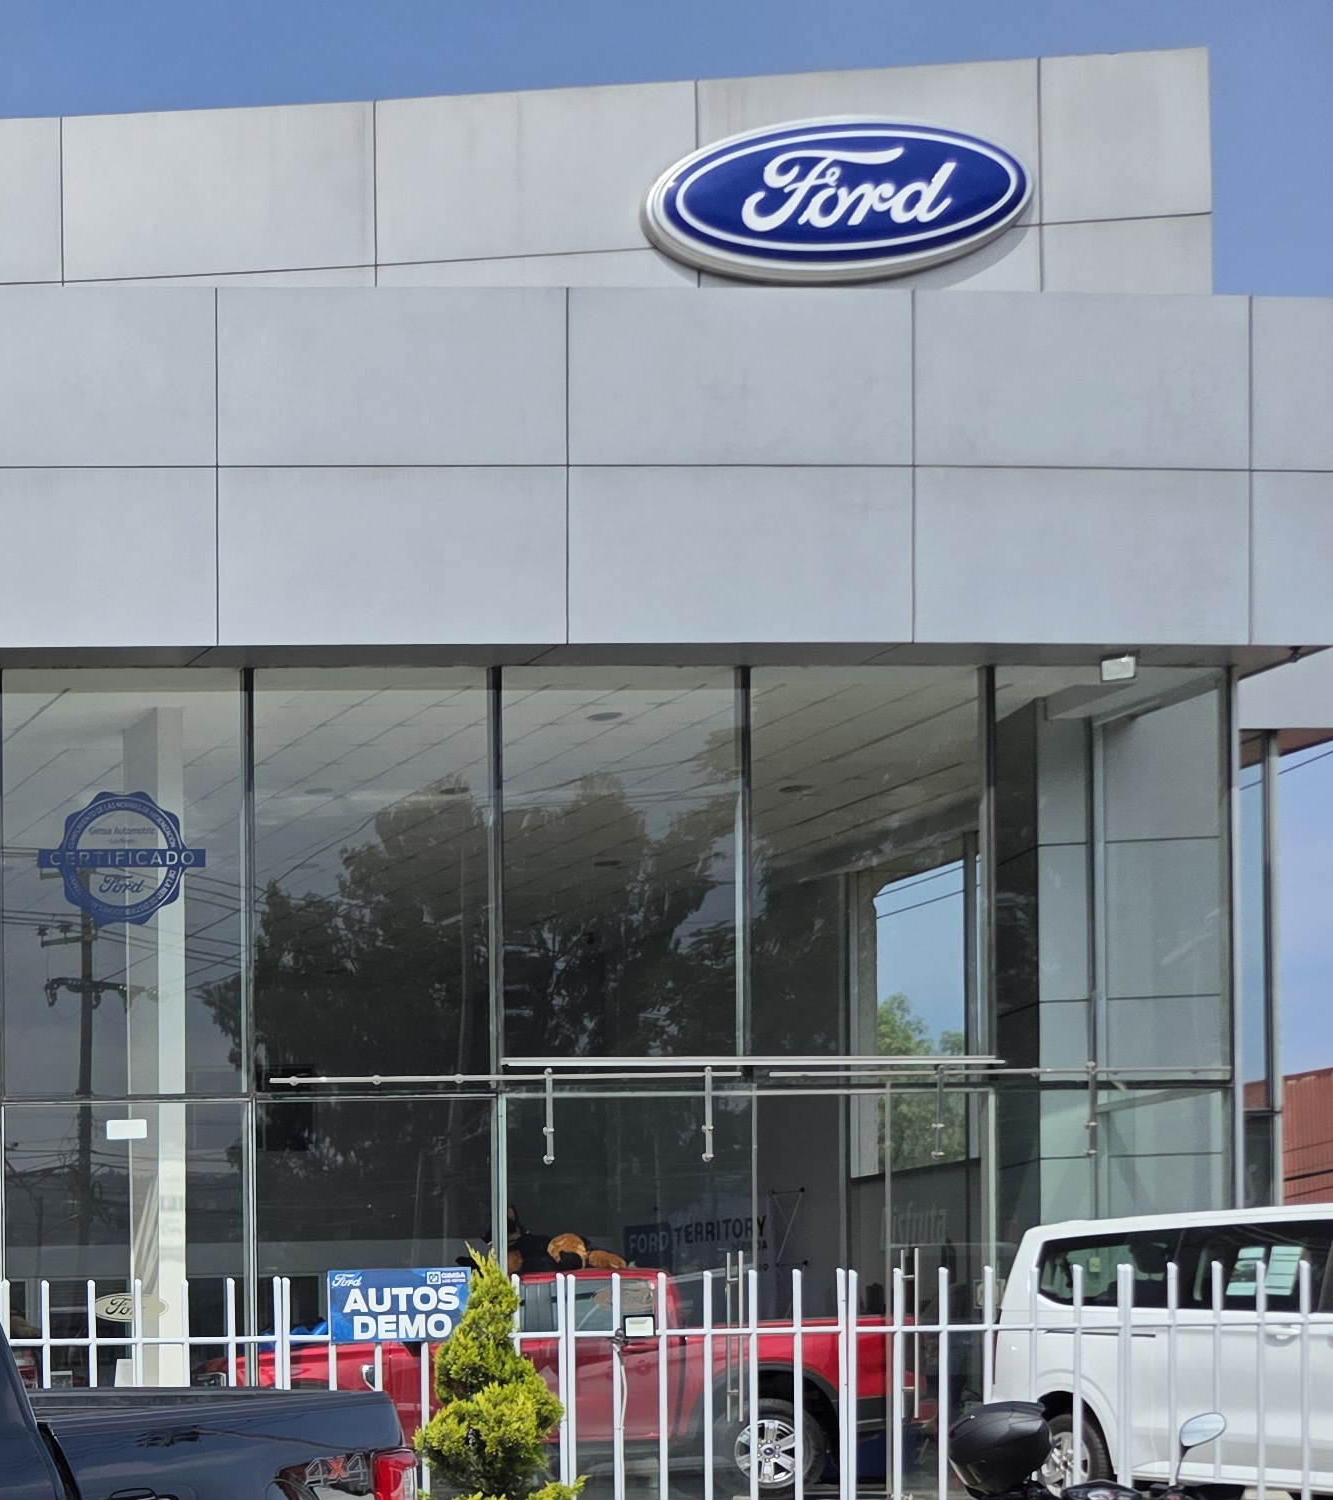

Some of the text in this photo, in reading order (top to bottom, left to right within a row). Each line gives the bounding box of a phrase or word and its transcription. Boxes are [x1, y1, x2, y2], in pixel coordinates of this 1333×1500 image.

[741, 147, 956, 232] Ford
[49, 851, 195, 865] CERTIFICADO
[99, 874, 146, 894] Ford
[629, 1231, 668, 1254] FORD
[332, 1273, 362, 1287] Ford
[343, 1286, 460, 1313] AUTOS
[353, 1313, 452, 1340] DEMO
